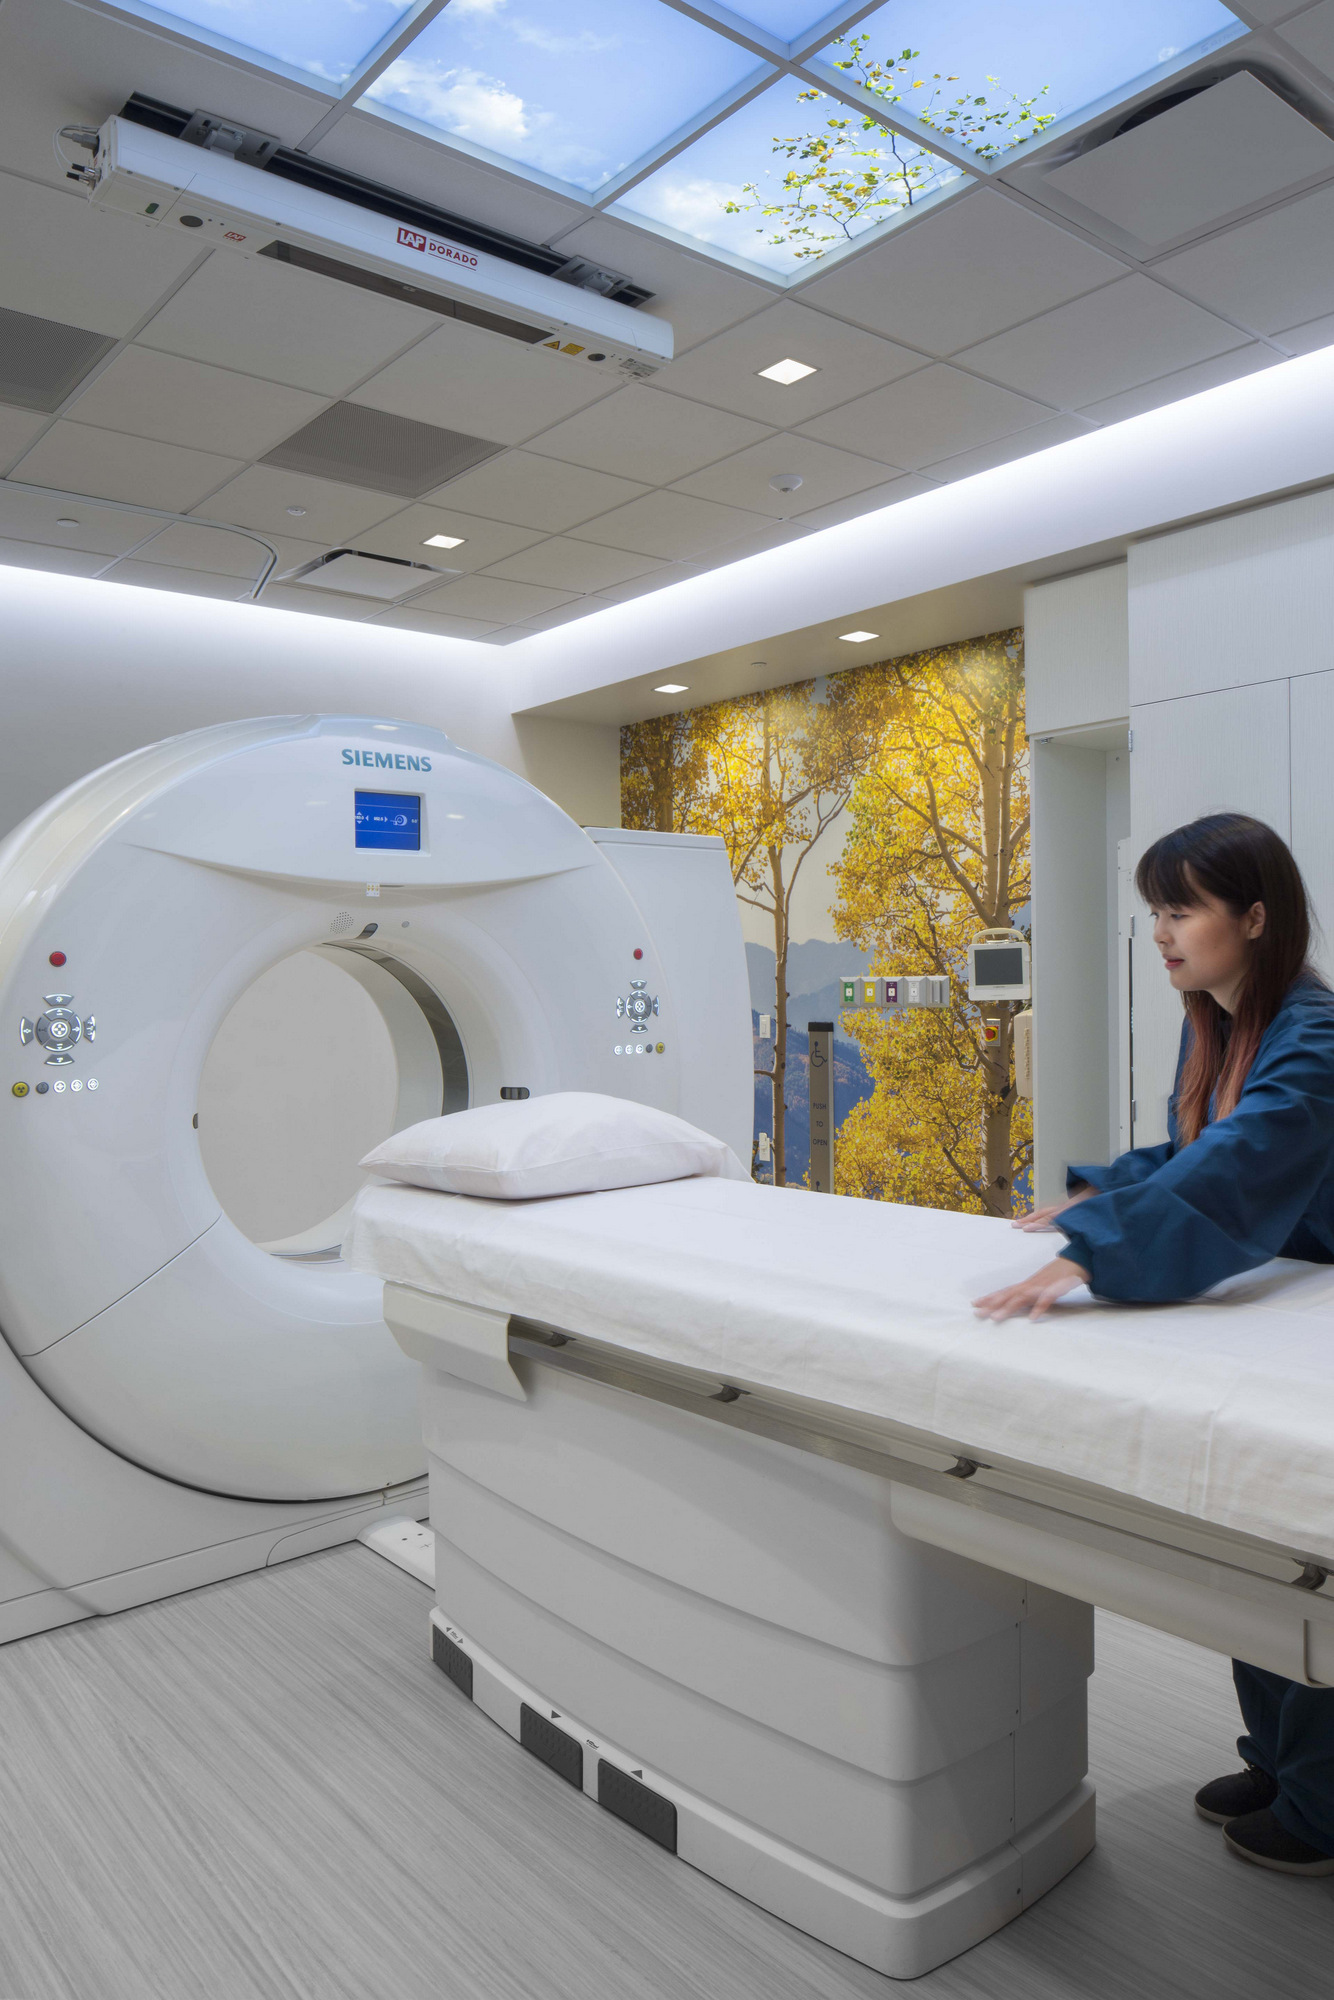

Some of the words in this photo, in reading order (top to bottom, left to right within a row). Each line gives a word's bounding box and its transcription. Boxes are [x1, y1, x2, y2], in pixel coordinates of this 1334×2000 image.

[399, 229, 425, 249] LAP
[429, 242, 478, 267] DORADO
[341, 748, 432, 773] SIEMENS
[812, 1102, 827, 1110] PUSH
[816, 1120, 824, 1128] TO
[812, 1138, 828, 1146] OPEN
